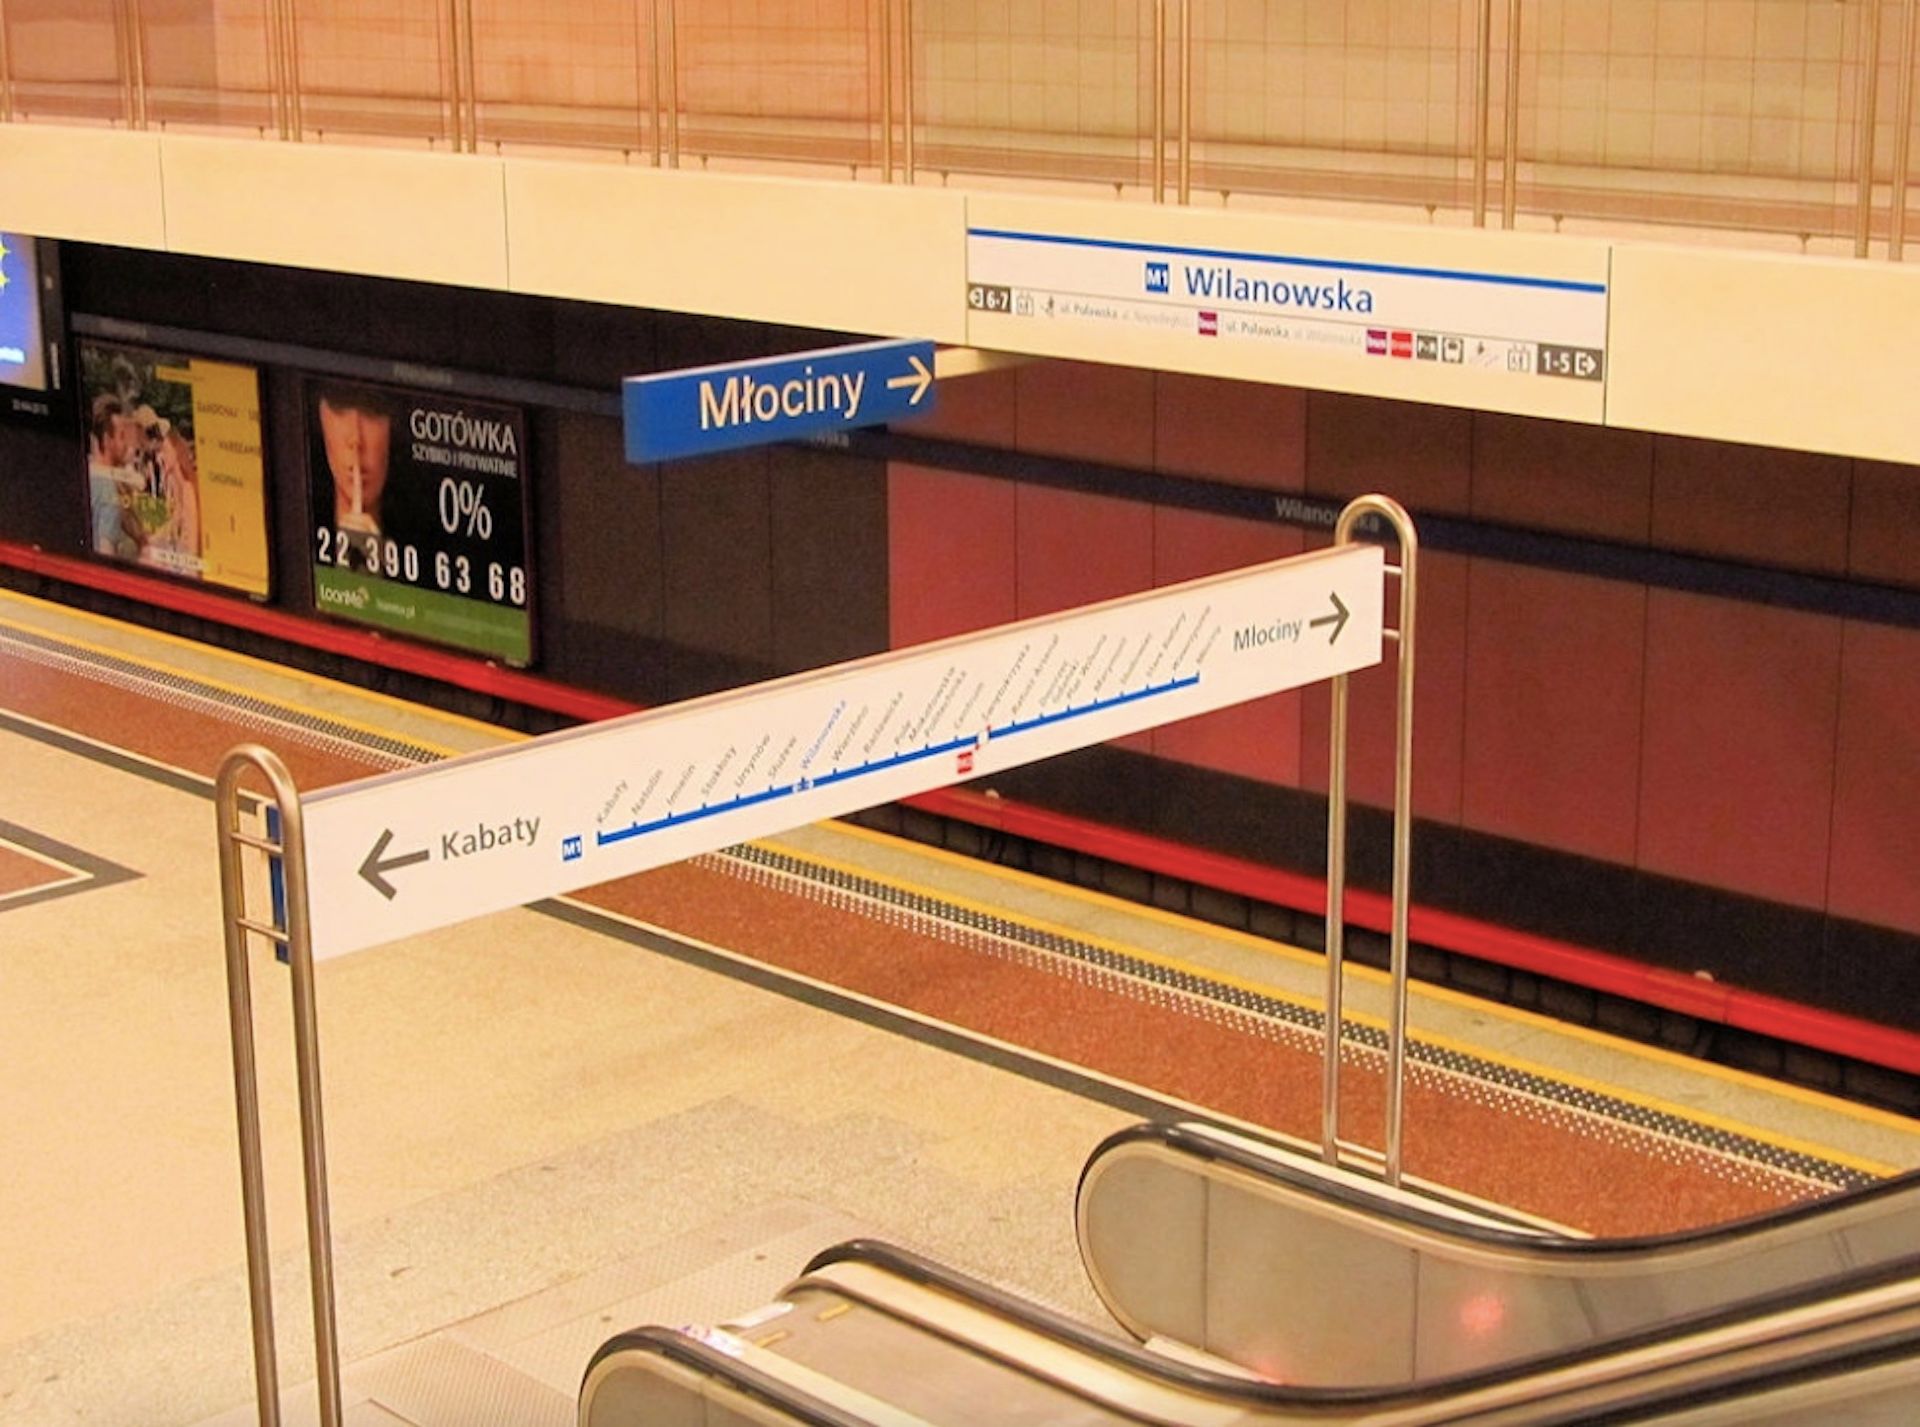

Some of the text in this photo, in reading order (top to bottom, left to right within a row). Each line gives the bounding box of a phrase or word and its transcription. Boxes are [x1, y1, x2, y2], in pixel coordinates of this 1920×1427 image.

[1146, 266, 1373, 313] M1 Wilanowska
[1543, 351, 1570, 374] 1-5
[700, 366, 865, 430] Młociny
[410, 408, 517, 456] GOTÓWKA
[438, 477, 492, 540] 0%
[1276, 498, 1380, 533] Wilanoka
[317, 526, 526, 606] 22 390 63 68
[441, 816, 541, 860] Kabaty
